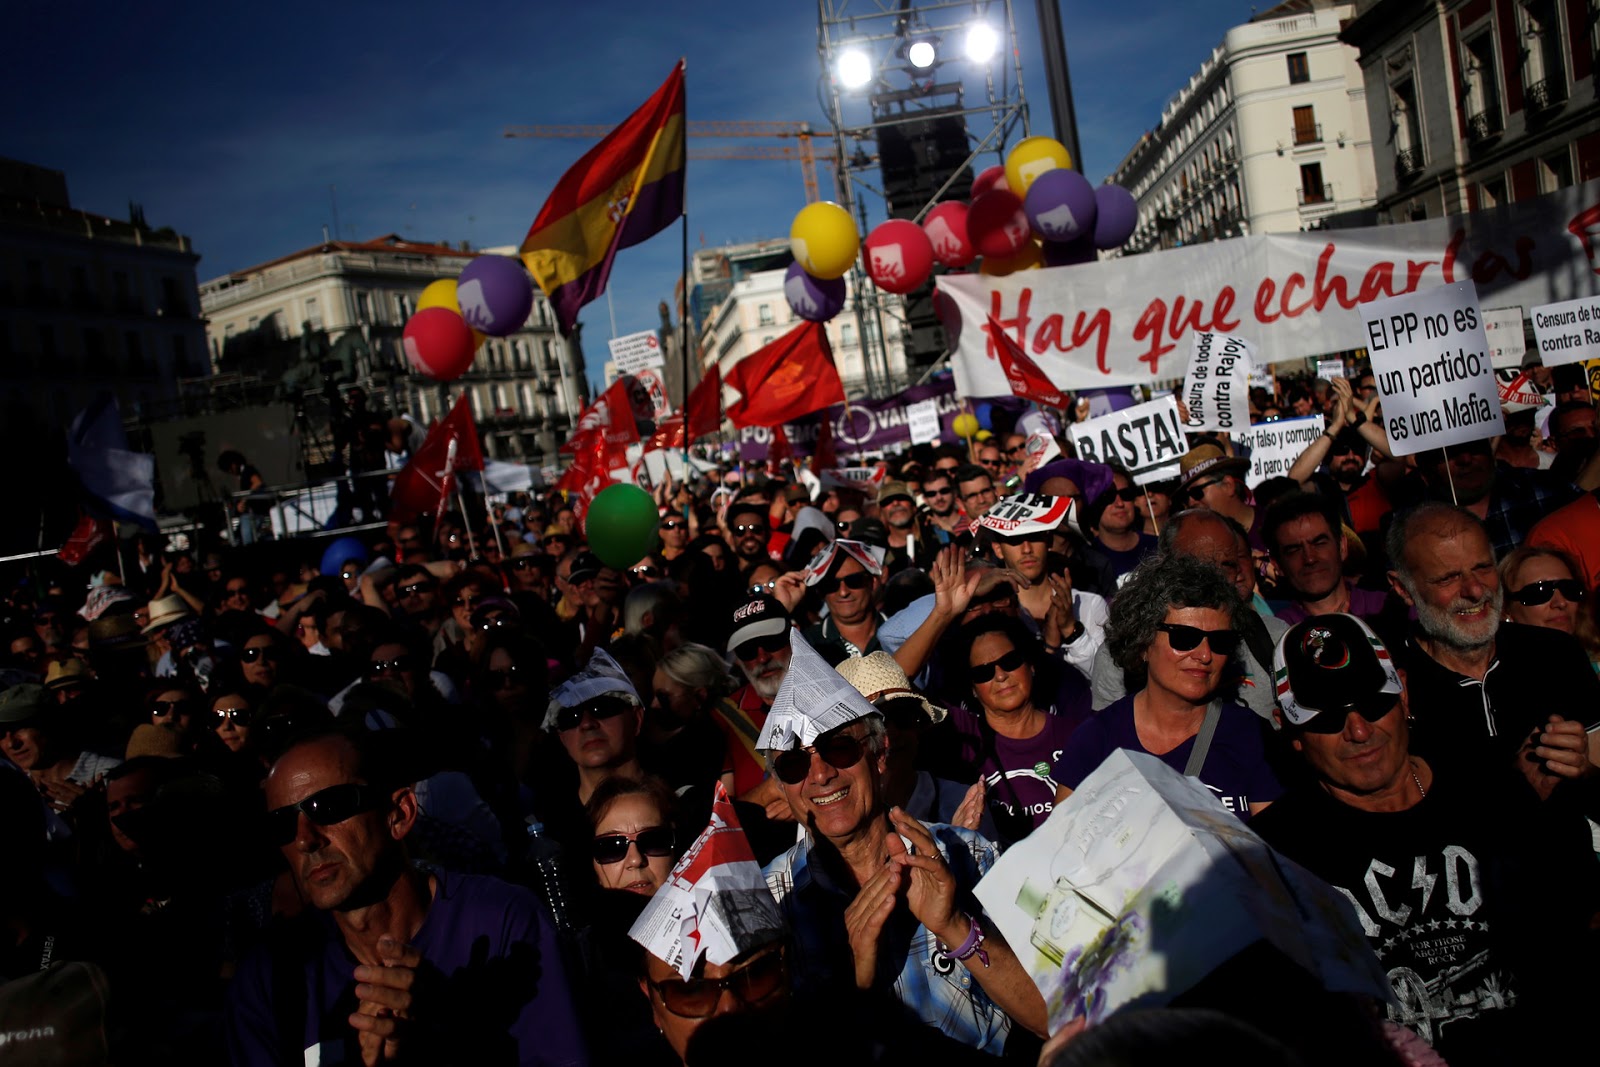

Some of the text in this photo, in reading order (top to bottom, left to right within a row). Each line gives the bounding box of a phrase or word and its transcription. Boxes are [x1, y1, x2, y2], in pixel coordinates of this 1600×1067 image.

[1367, 306, 1478, 351] El PP no es
[1536, 311, 1577, 329] Censura
[1577, 306, 1591, 322] de
[1132, 286, 1241, 375] que
[1541, 334, 1582, 352] contra
[1191, 365, 1208, 380] de
[1379, 348, 1488, 398] un partido:
[1187, 381, 1206, 427] Censura
[1212, 381, 1233, 428] contra
[1389, 392, 1497, 441] es una Mafia.
[1256, 429, 1277, 448] falso
[1278, 430, 1284, 450] y
[1263, 458, 1283, 480] paro
[1410, 934, 1468, 951] FOR THOSE
[1414, 943, 1467, 959] ABOUT TO
[1428, 952, 1458, 966] ROCK
